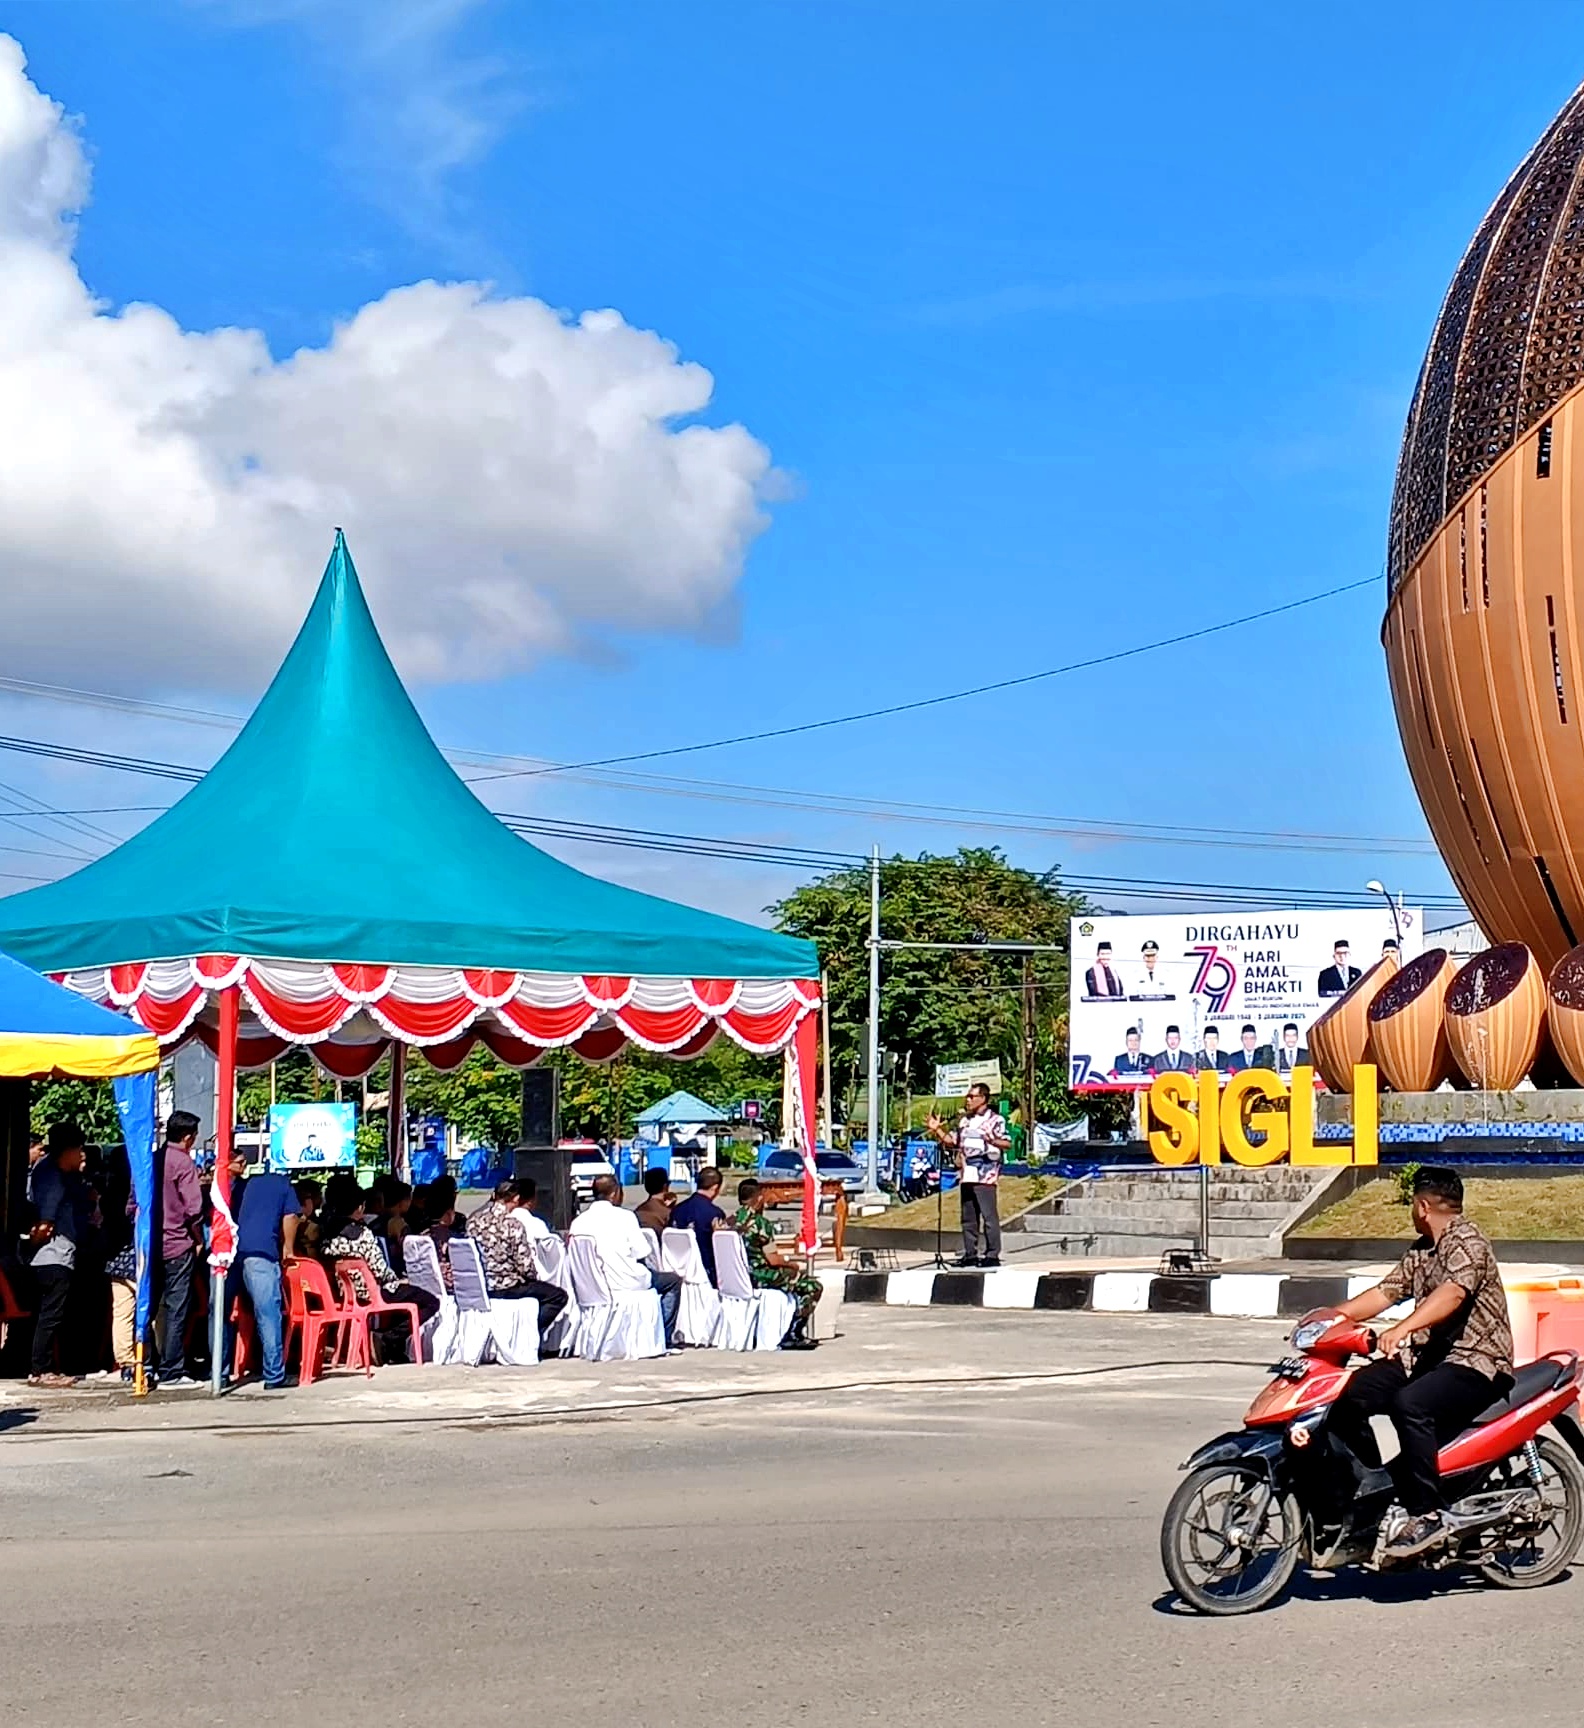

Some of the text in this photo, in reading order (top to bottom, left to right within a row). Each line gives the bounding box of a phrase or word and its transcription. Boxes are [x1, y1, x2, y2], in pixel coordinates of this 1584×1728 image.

[1185, 923, 1299, 941] DIRGAHAYU
[1243, 950, 1281, 963] HARI
[1183, 945, 1237, 1013] 79
[1244, 965, 1289, 978] AMAL
[1243, 980, 1302, 993] BHAKTI
[1150, 1063, 1379, 1167] SIGLI
